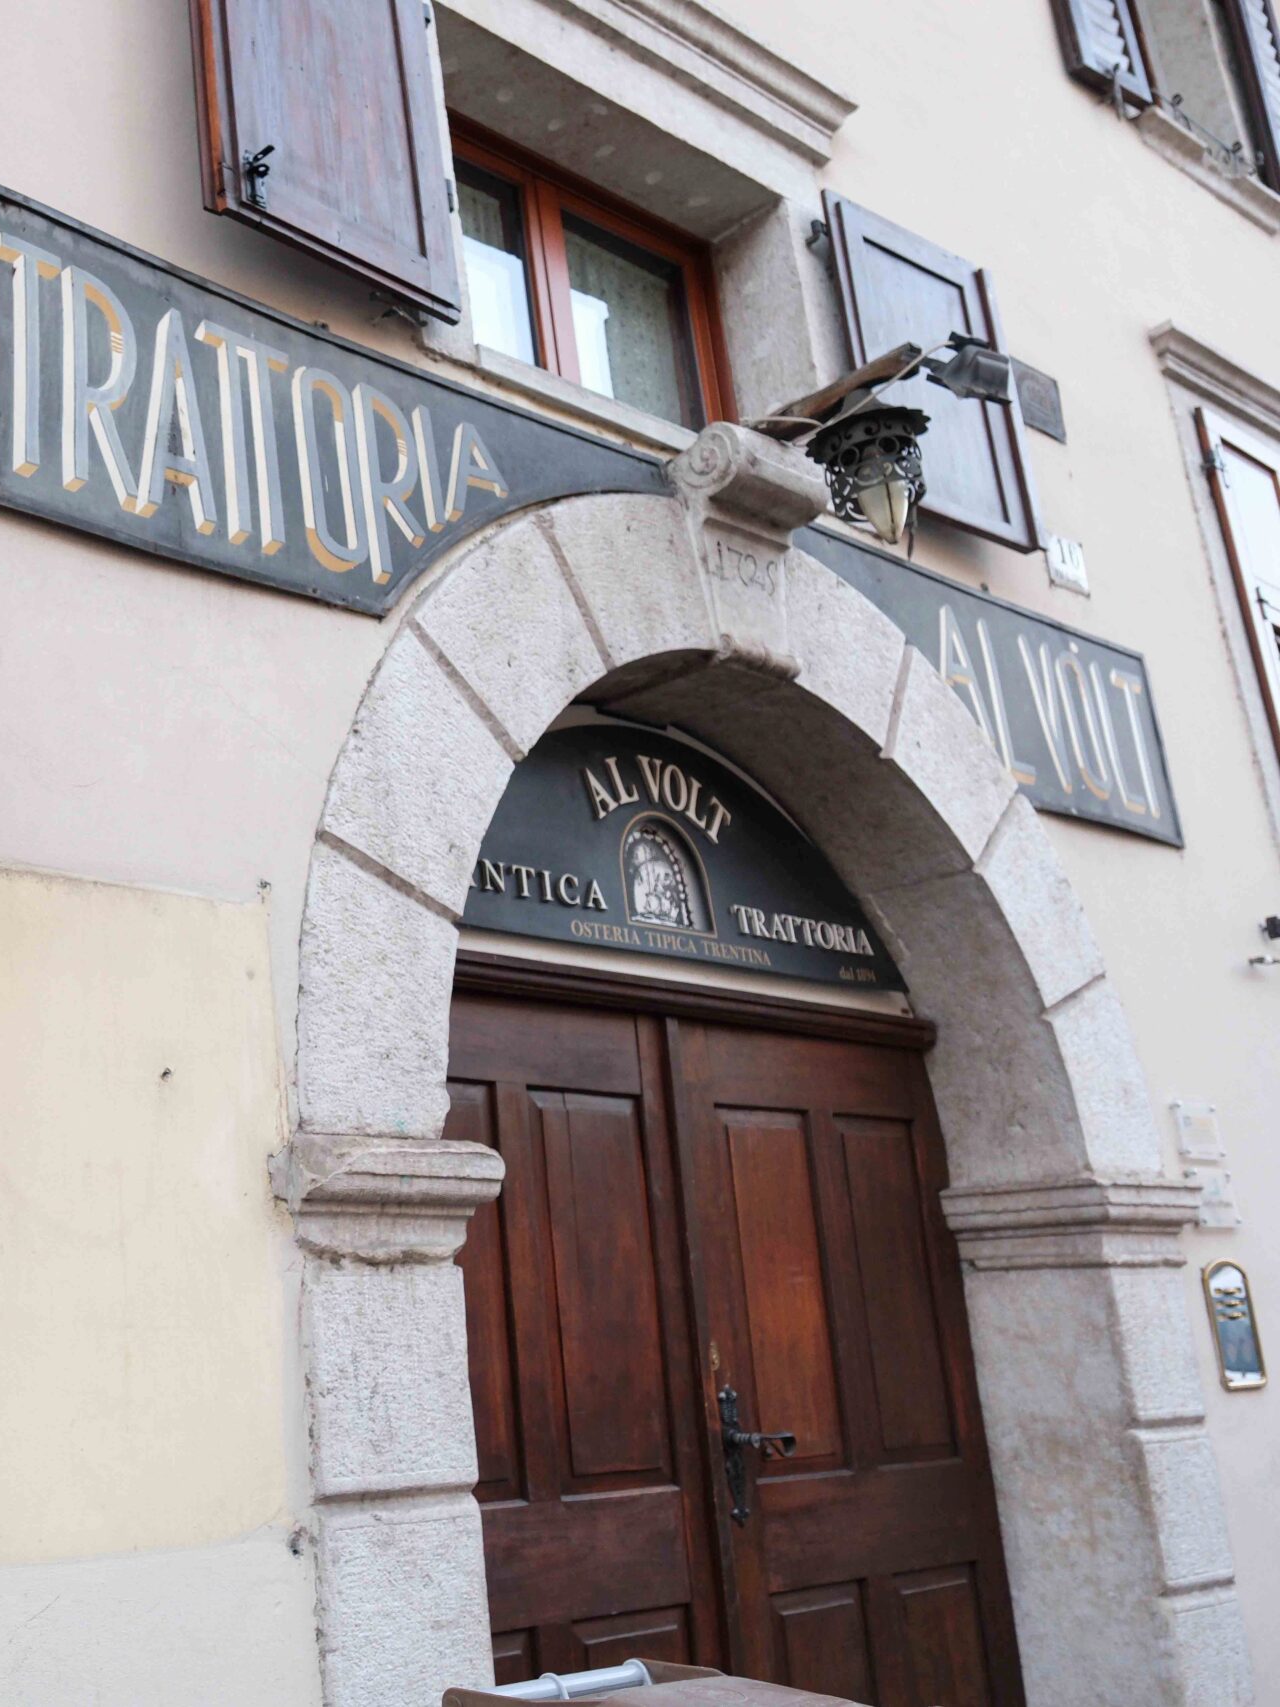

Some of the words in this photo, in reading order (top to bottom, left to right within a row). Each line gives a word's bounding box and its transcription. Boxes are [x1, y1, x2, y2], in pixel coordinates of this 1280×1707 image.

[939, 604, 1037, 787] AL
[584, 756, 640, 820] AL
[636, 754, 732, 845] VOLT
[571, 919, 641, 946] OSTERIA
[645, 930, 698, 954] TIPICA
[703, 940, 772, 967] TRENTINA
[729, 903, 875, 957] TRATTORIA
